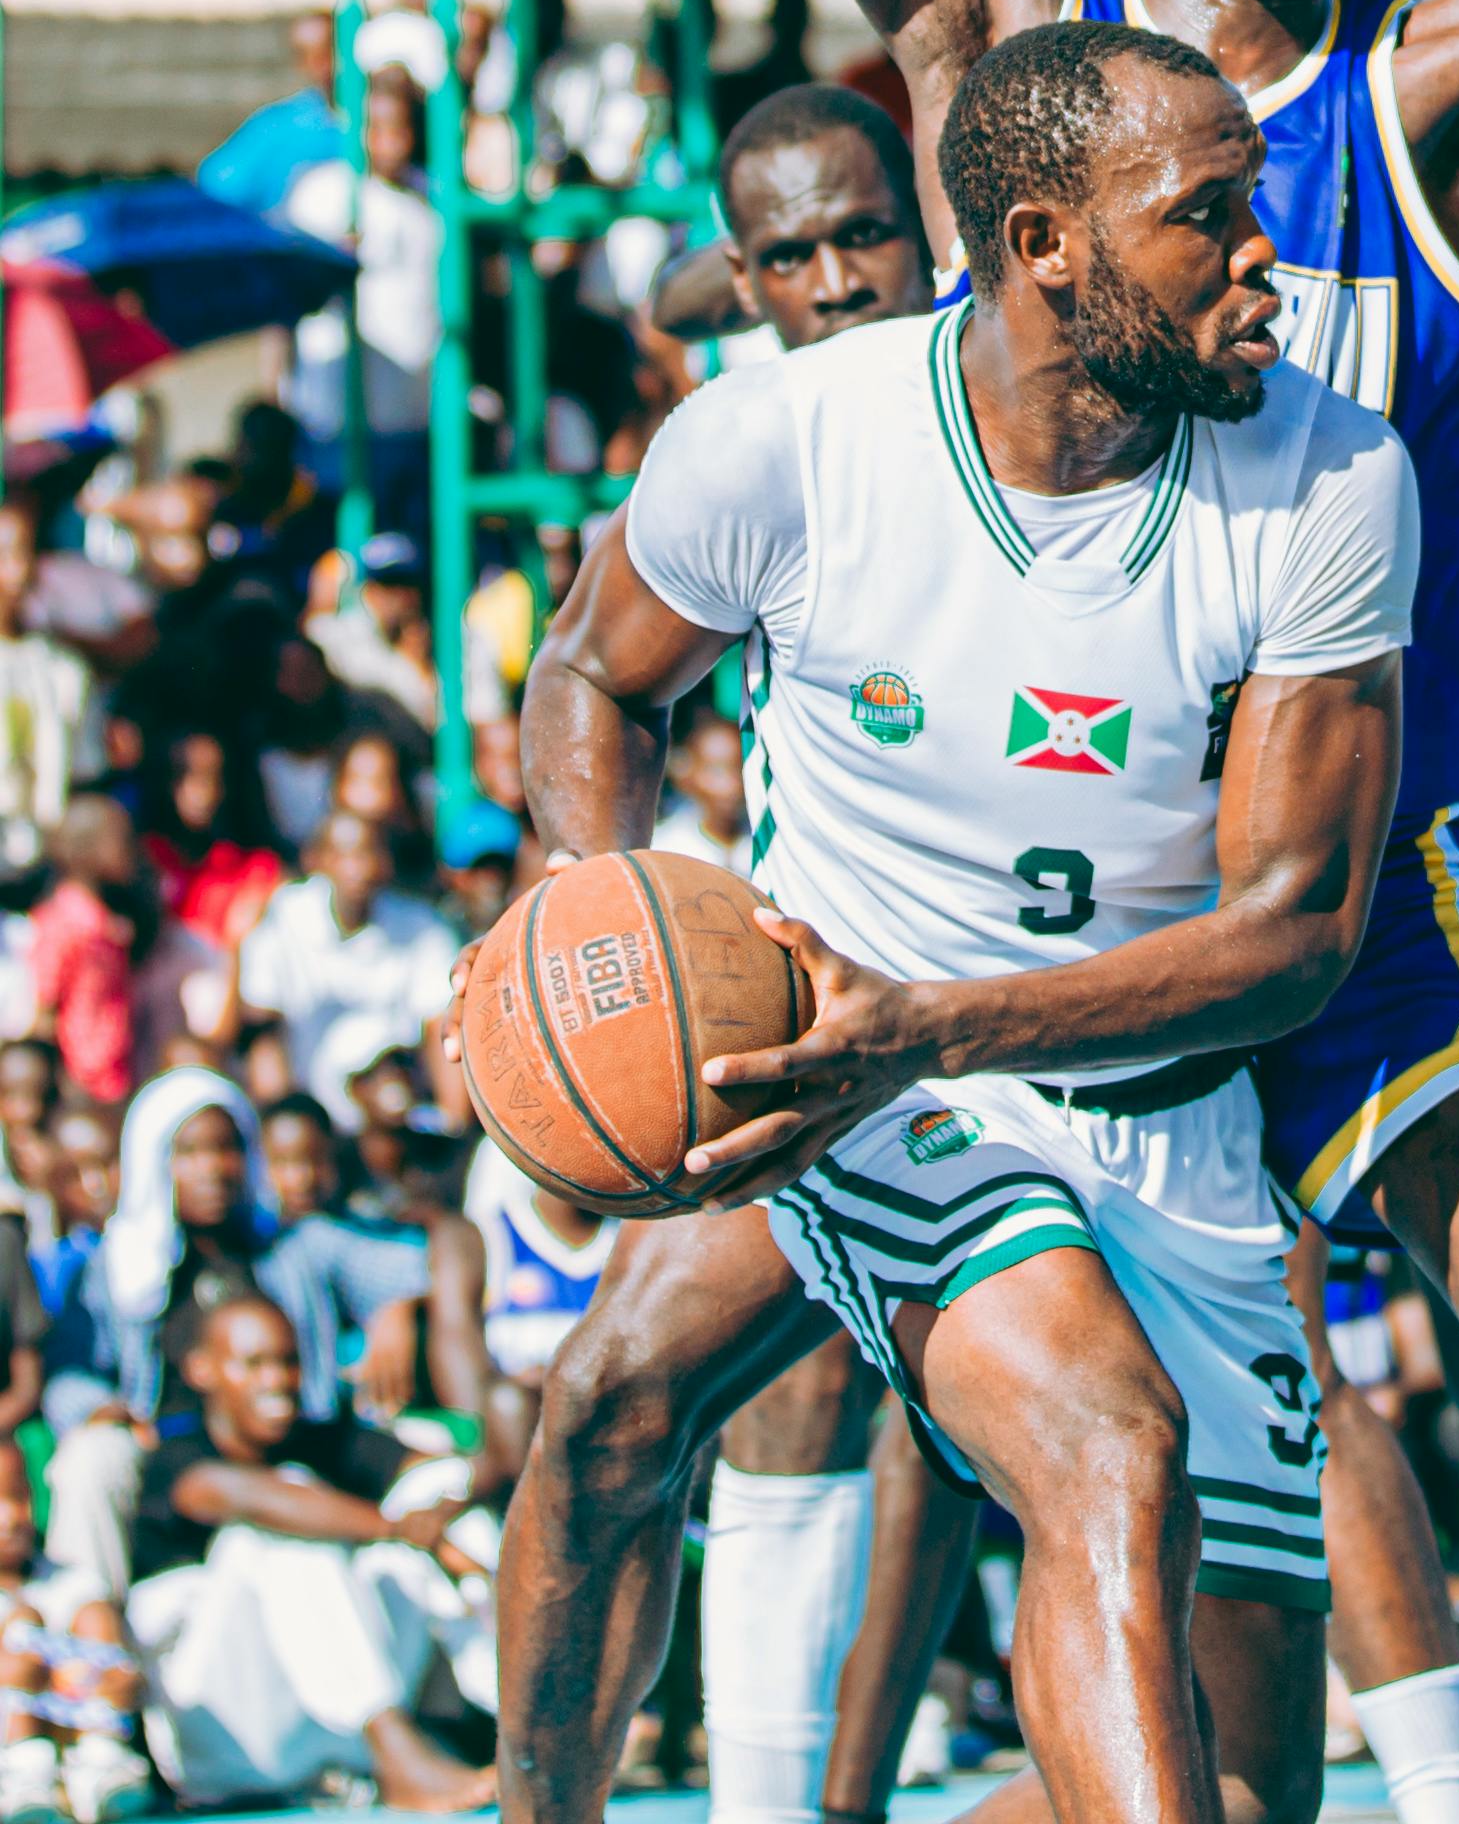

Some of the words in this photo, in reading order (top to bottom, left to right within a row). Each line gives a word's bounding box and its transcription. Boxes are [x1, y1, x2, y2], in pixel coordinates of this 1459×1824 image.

[855, 703, 917, 728] DYNAMO
[582, 936, 631, 1016] FIBA
[621, 931, 650, 1005] APPROVED
